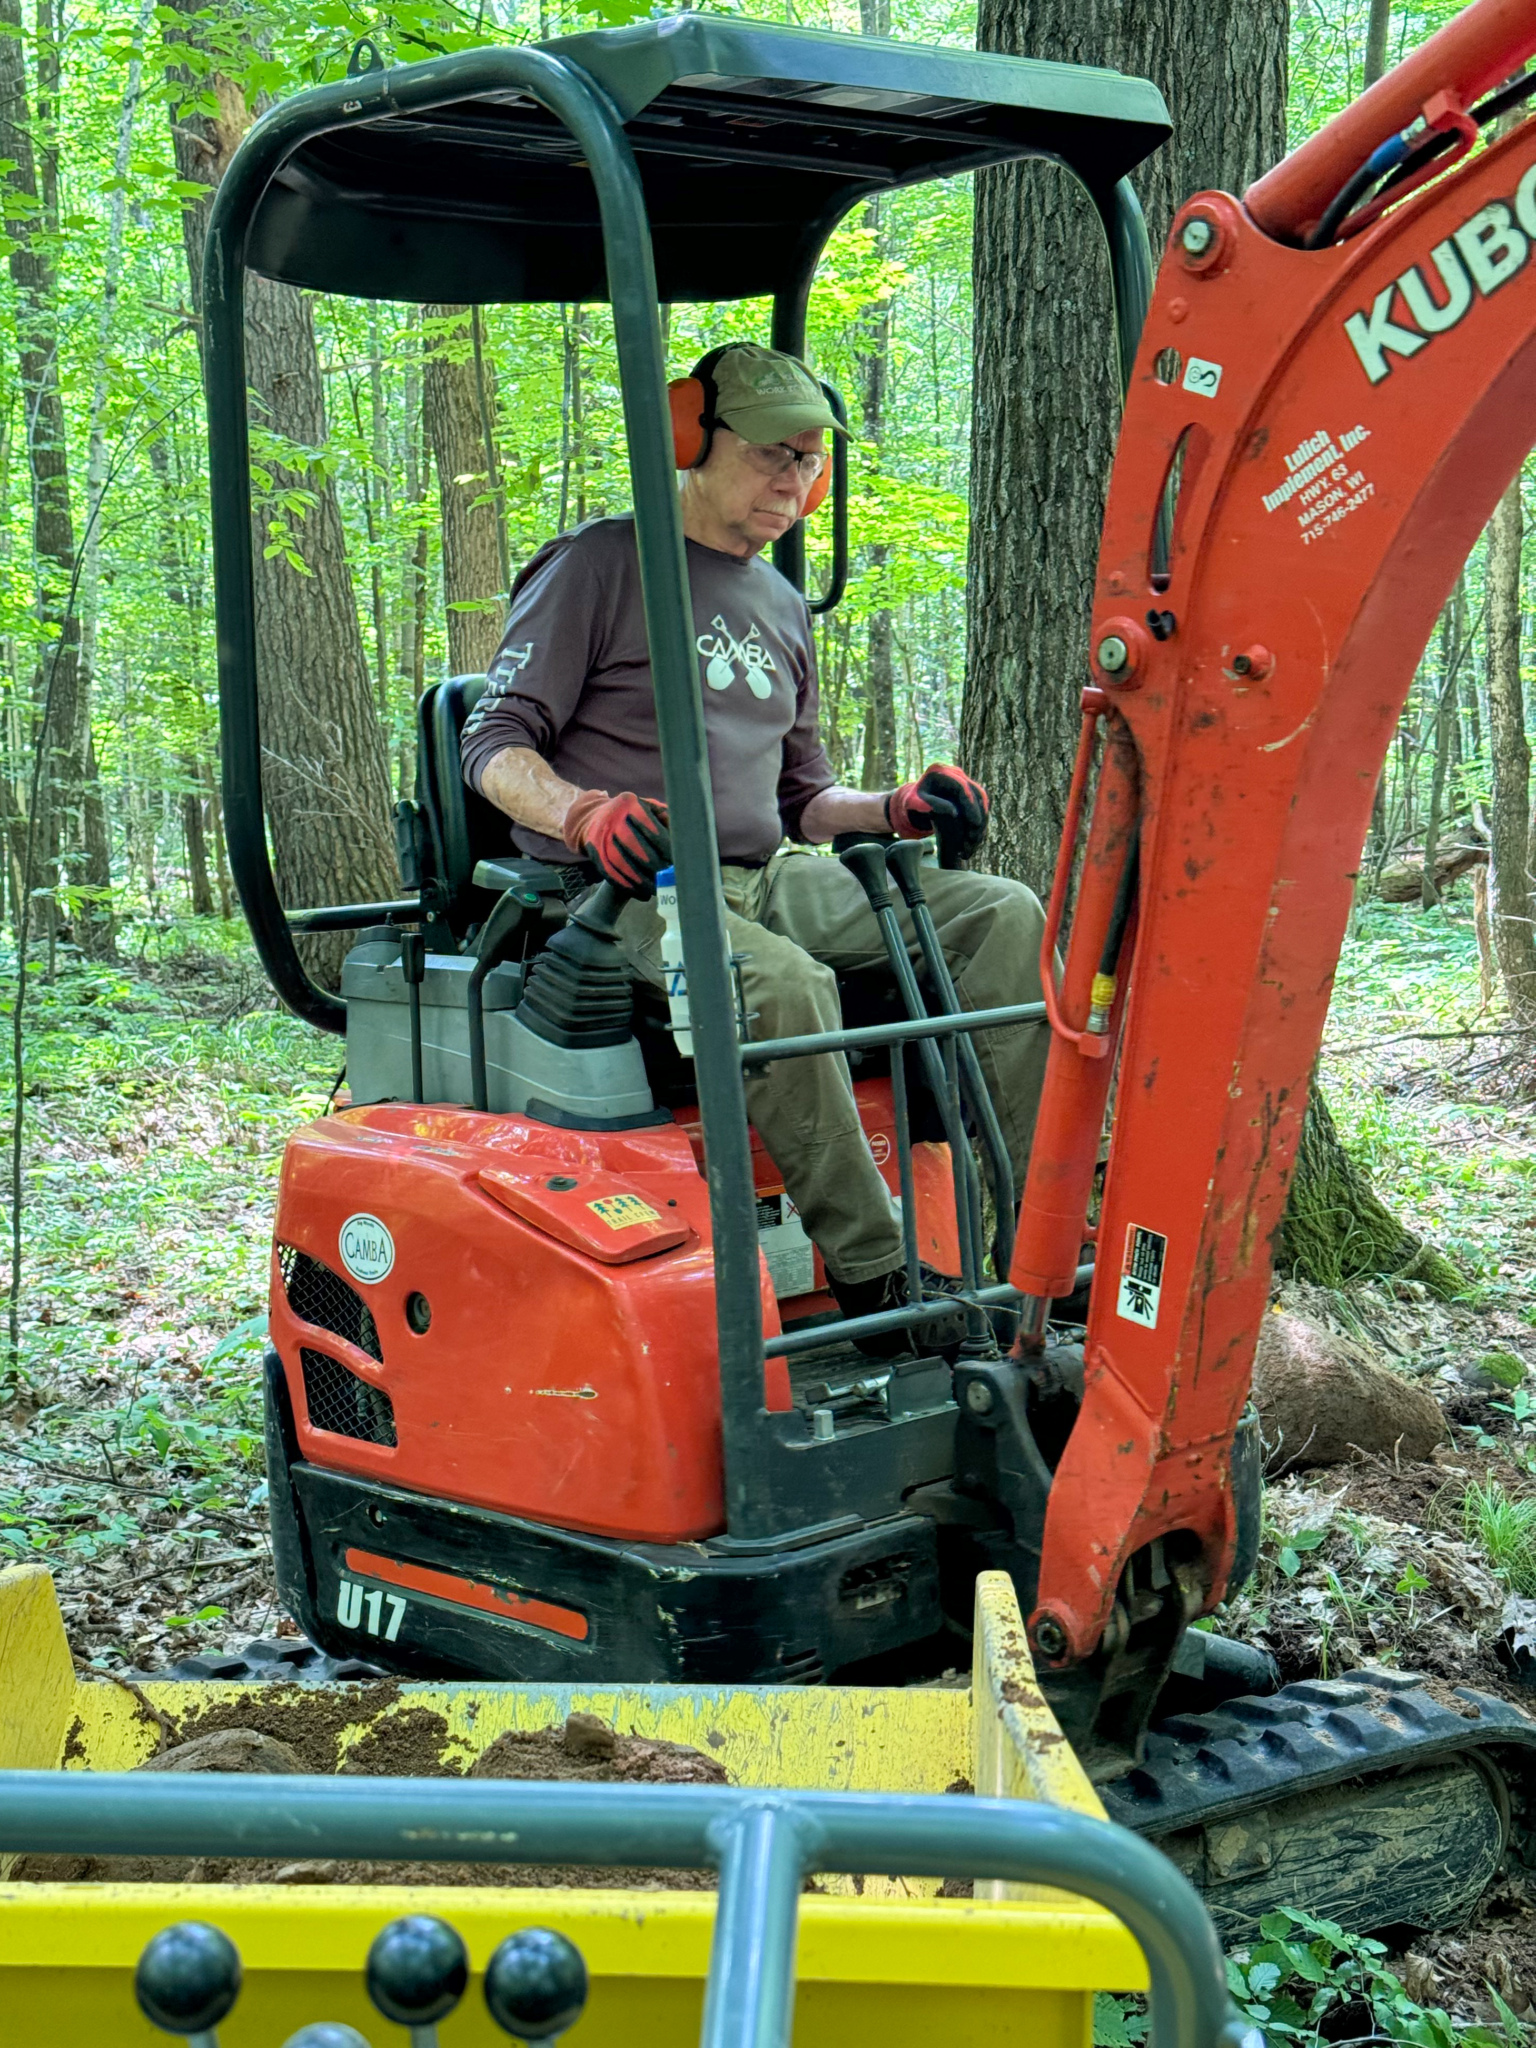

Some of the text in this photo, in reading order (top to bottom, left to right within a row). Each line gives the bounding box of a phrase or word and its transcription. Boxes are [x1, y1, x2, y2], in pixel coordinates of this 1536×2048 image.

[1283, 430, 1331, 472] Lulich
[1338, 424, 1372, 452] Inc.
[1299, 463, 1348, 506] HWY. 63
[1345, 470, 1366, 490] WI
[1300, 482, 1375, 545] 715-746-2477
[696, 633, 776, 671] CAMBA
[344, 1231, 388, 1264] CAMBA
[337, 1580, 407, 1642] U17
